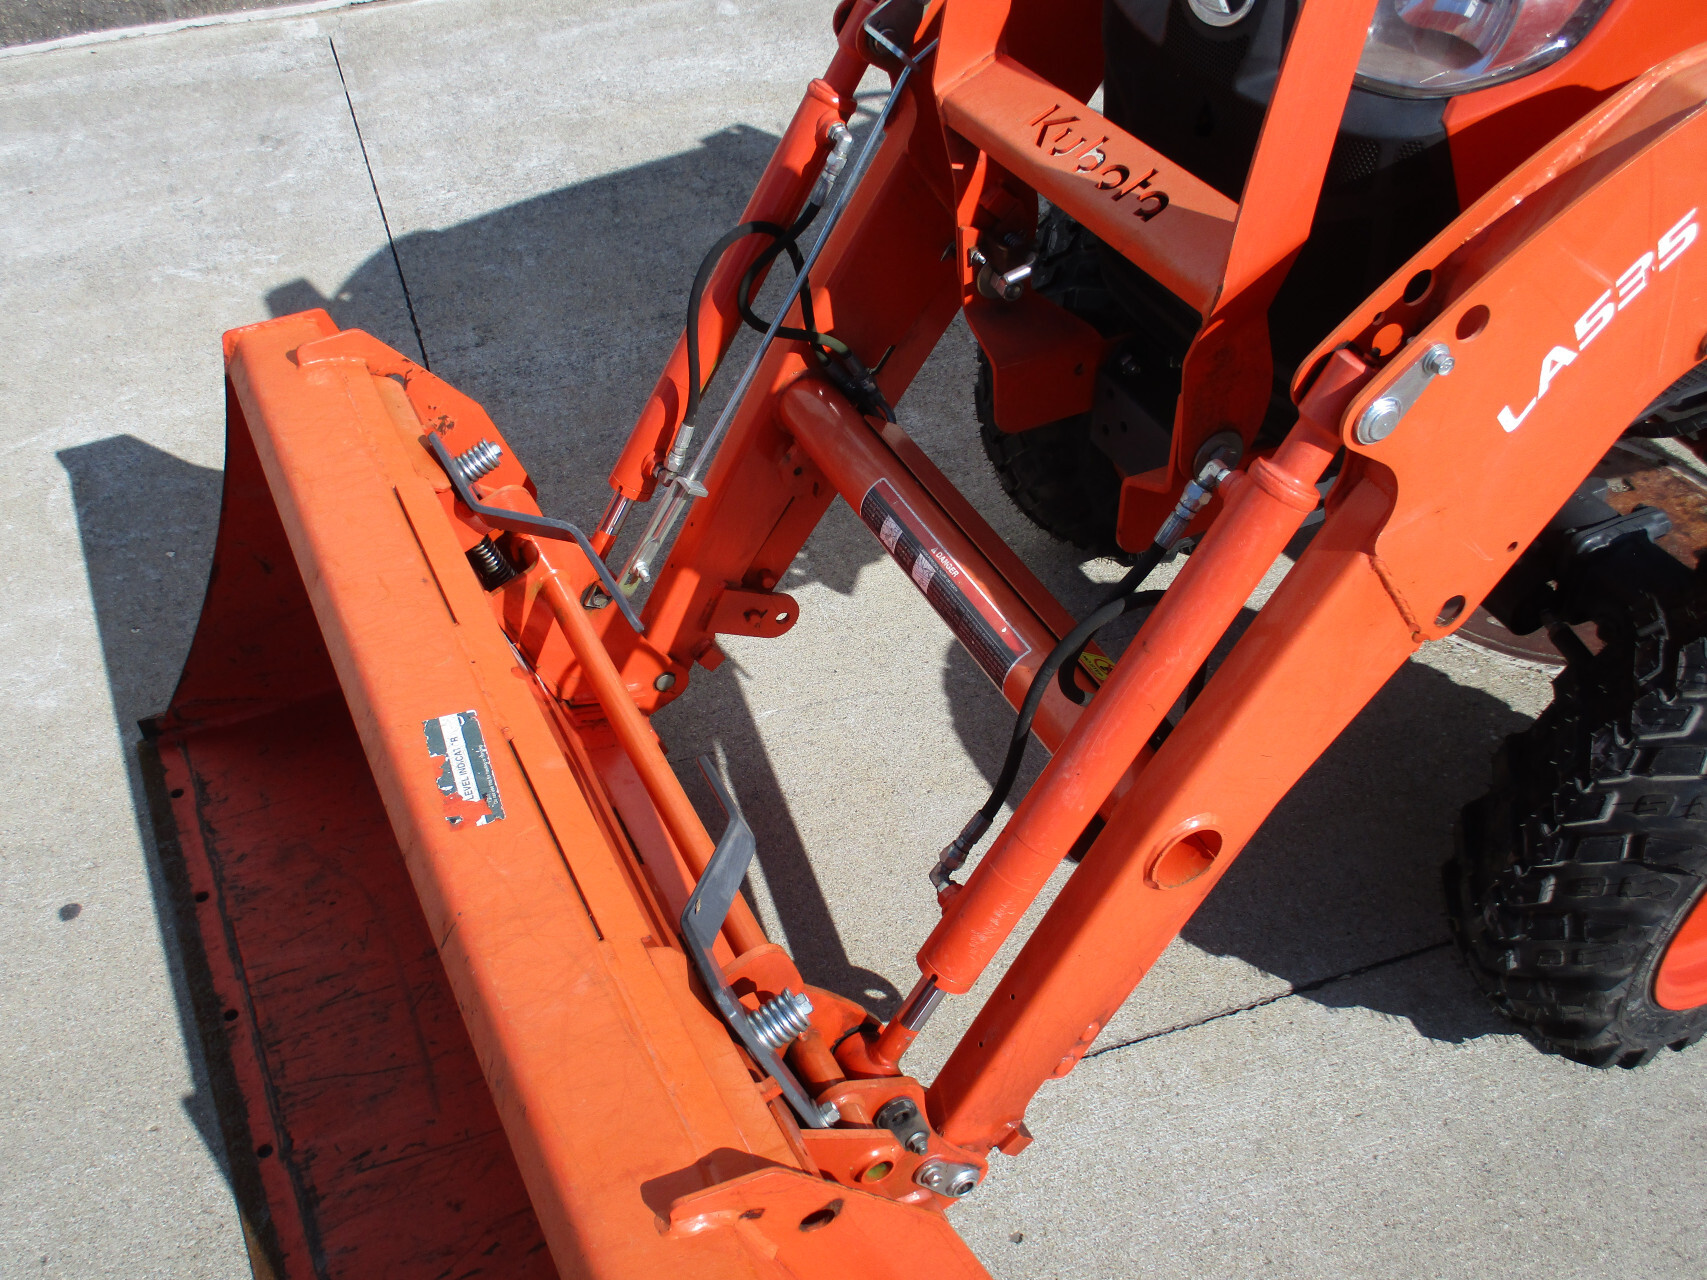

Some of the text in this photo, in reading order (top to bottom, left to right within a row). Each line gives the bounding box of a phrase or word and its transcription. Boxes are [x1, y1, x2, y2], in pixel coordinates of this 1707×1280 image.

[1030, 104, 1170, 222] Kubota
[1497, 207, 1698, 432] LA535
[935, 551, 960, 578] DANGER
[461, 776, 474, 801] LEVEL
